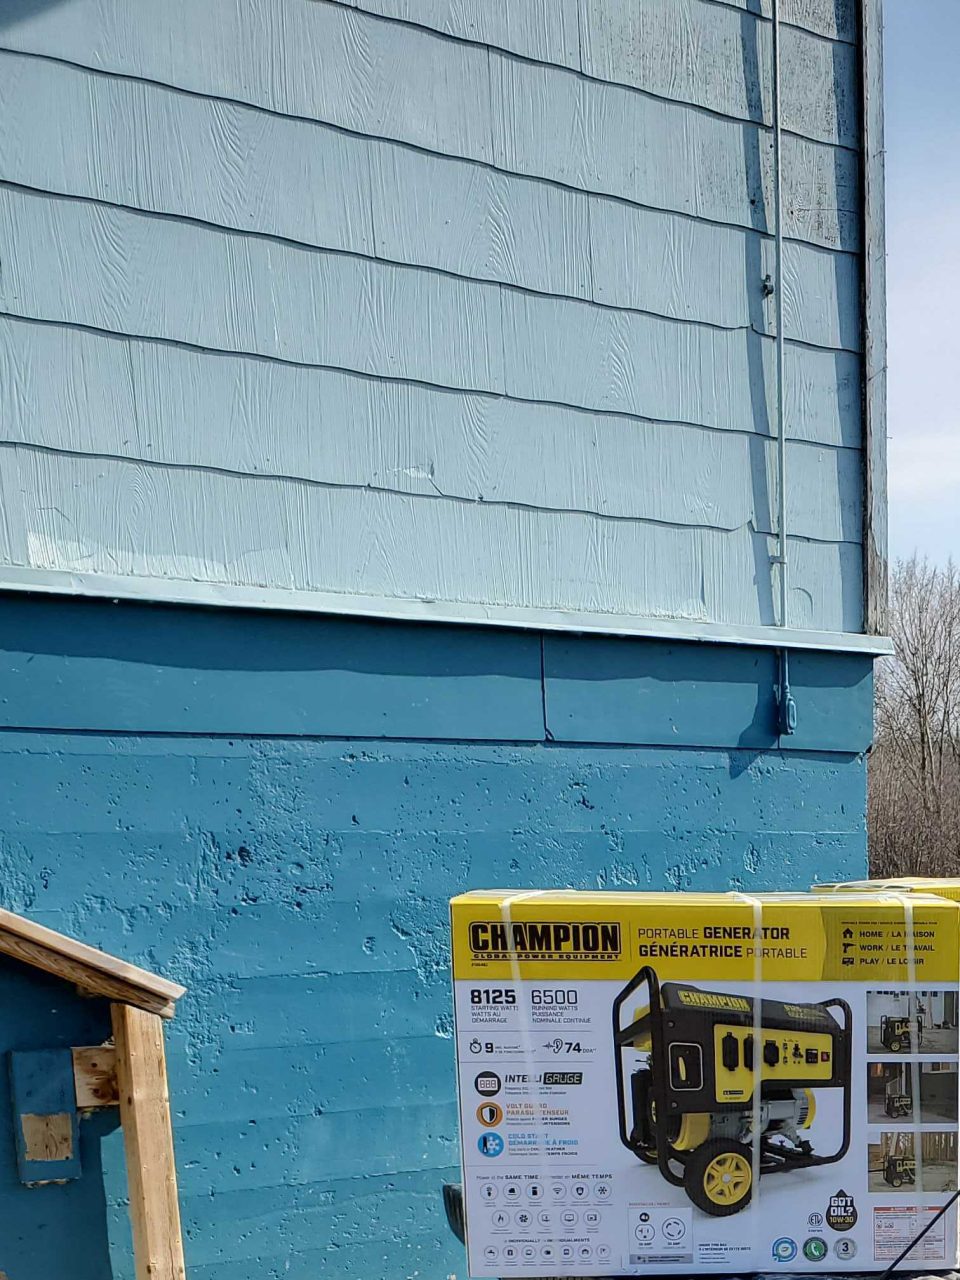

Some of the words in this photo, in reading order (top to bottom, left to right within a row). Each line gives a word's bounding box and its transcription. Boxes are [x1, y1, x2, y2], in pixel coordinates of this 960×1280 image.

[470, 922, 621, 953] CHAMPION
[638, 928, 699, 939] PORTABLE
[703, 926, 790, 940] GENERATOR
[638, 941, 743, 958] GÉNÉRATRICE
[470, 989, 517, 1005] 8125
[531, 989, 578, 1005] 6500
[679, 990, 751, 1010] CHAMPION
[485, 1042, 494, 1053] 9
[564, 1042, 582, 1054] 74
[504, 1074, 542, 1083] INTELI
[545, 1073, 581, 1084] GAUGE
[830, 1197, 853, 1206] GOT
[830, 1206, 854, 1216] OIL?
[841, 1241, 850, 1253] 3
